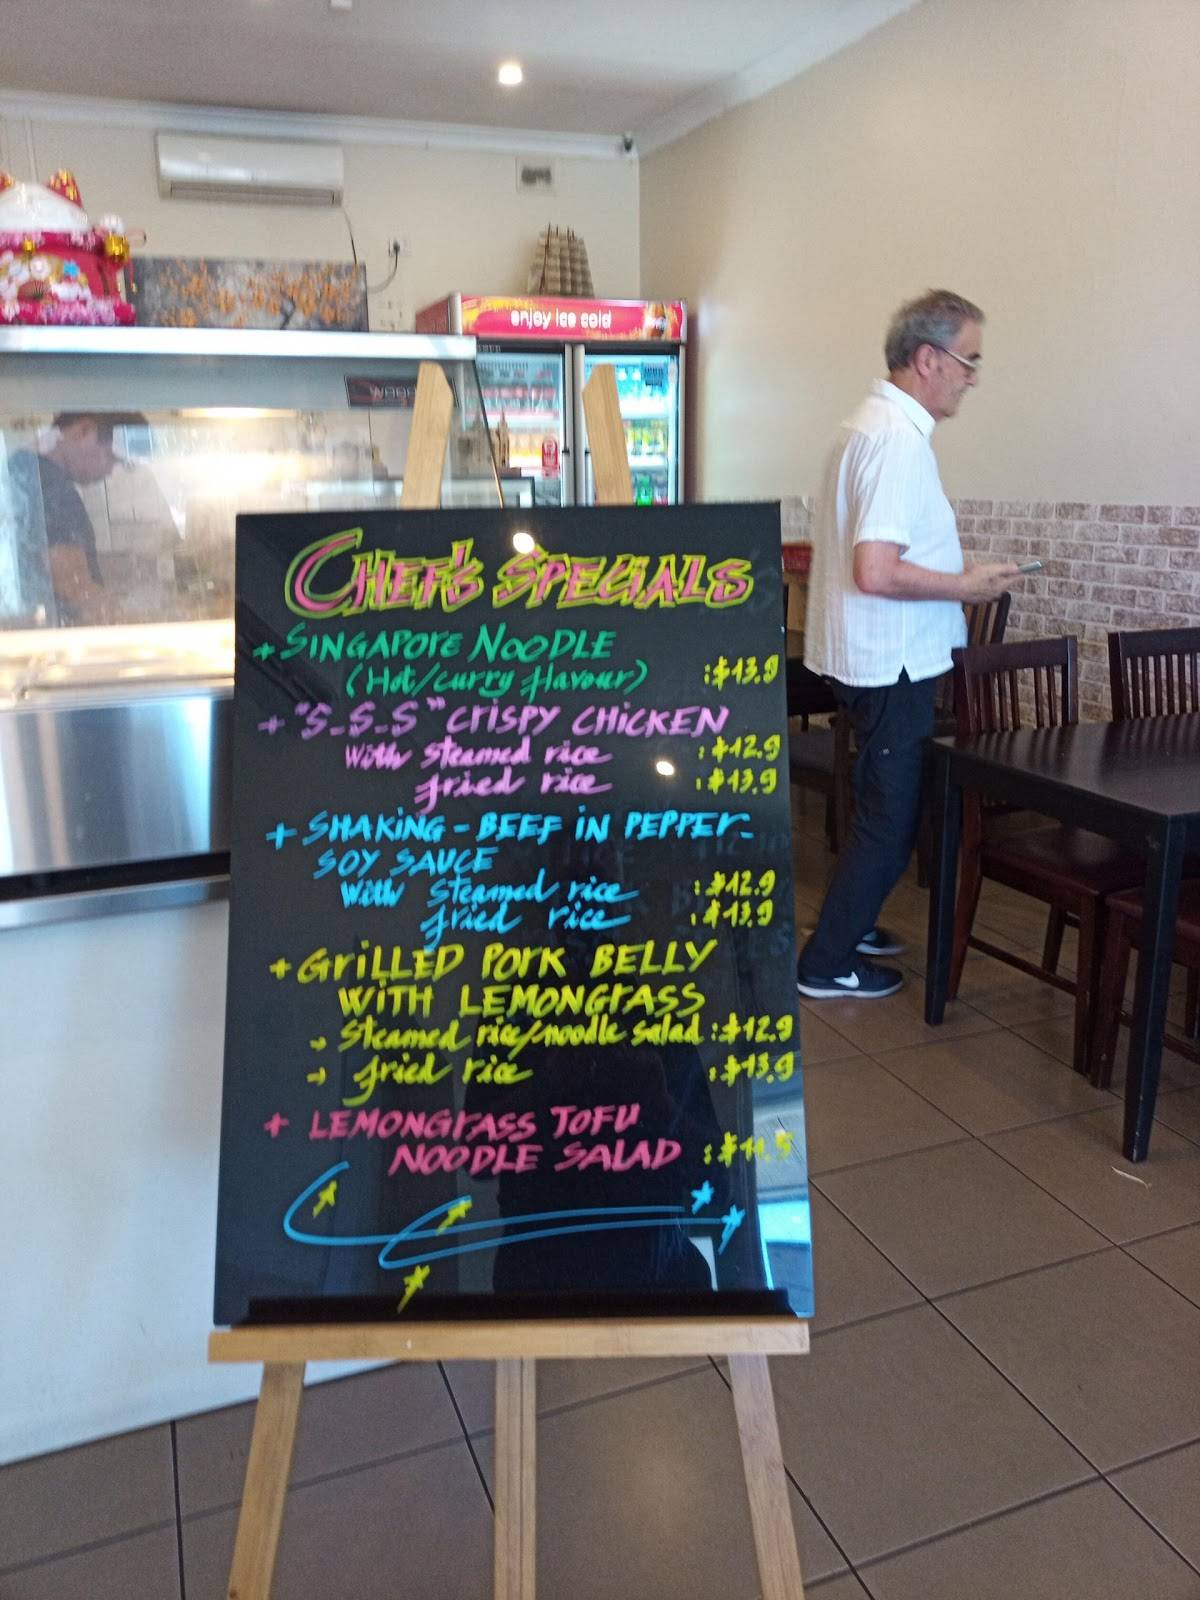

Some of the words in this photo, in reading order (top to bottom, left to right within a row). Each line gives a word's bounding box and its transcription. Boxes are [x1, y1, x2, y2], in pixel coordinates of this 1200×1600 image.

[510, 307, 551, 331] enjoy
[556, 307, 577, 329] ice
[580, 309, 612, 330] cold
[492, 544, 754, 609] SPECIALS
[468, 622, 617, 662] NOODLE
[544, 740, 613, 766] rice
[540, 767, 613, 794] rice
[476, 812, 562, 845] BEEF
[313, 848, 381, 880] SOY
[389, 846, 499, 876] SAUCE
[567, 876, 640, 903] rice
[548, 901, 631, 930] rice
[589, 939, 718, 978] BELLY
[462, 1054, 534, 1084] rice
[550, 1103, 641, 1139] TOFU
[388, 1143, 543, 1176] NOODLE
[554, 1138, 683, 1172] SALAD
